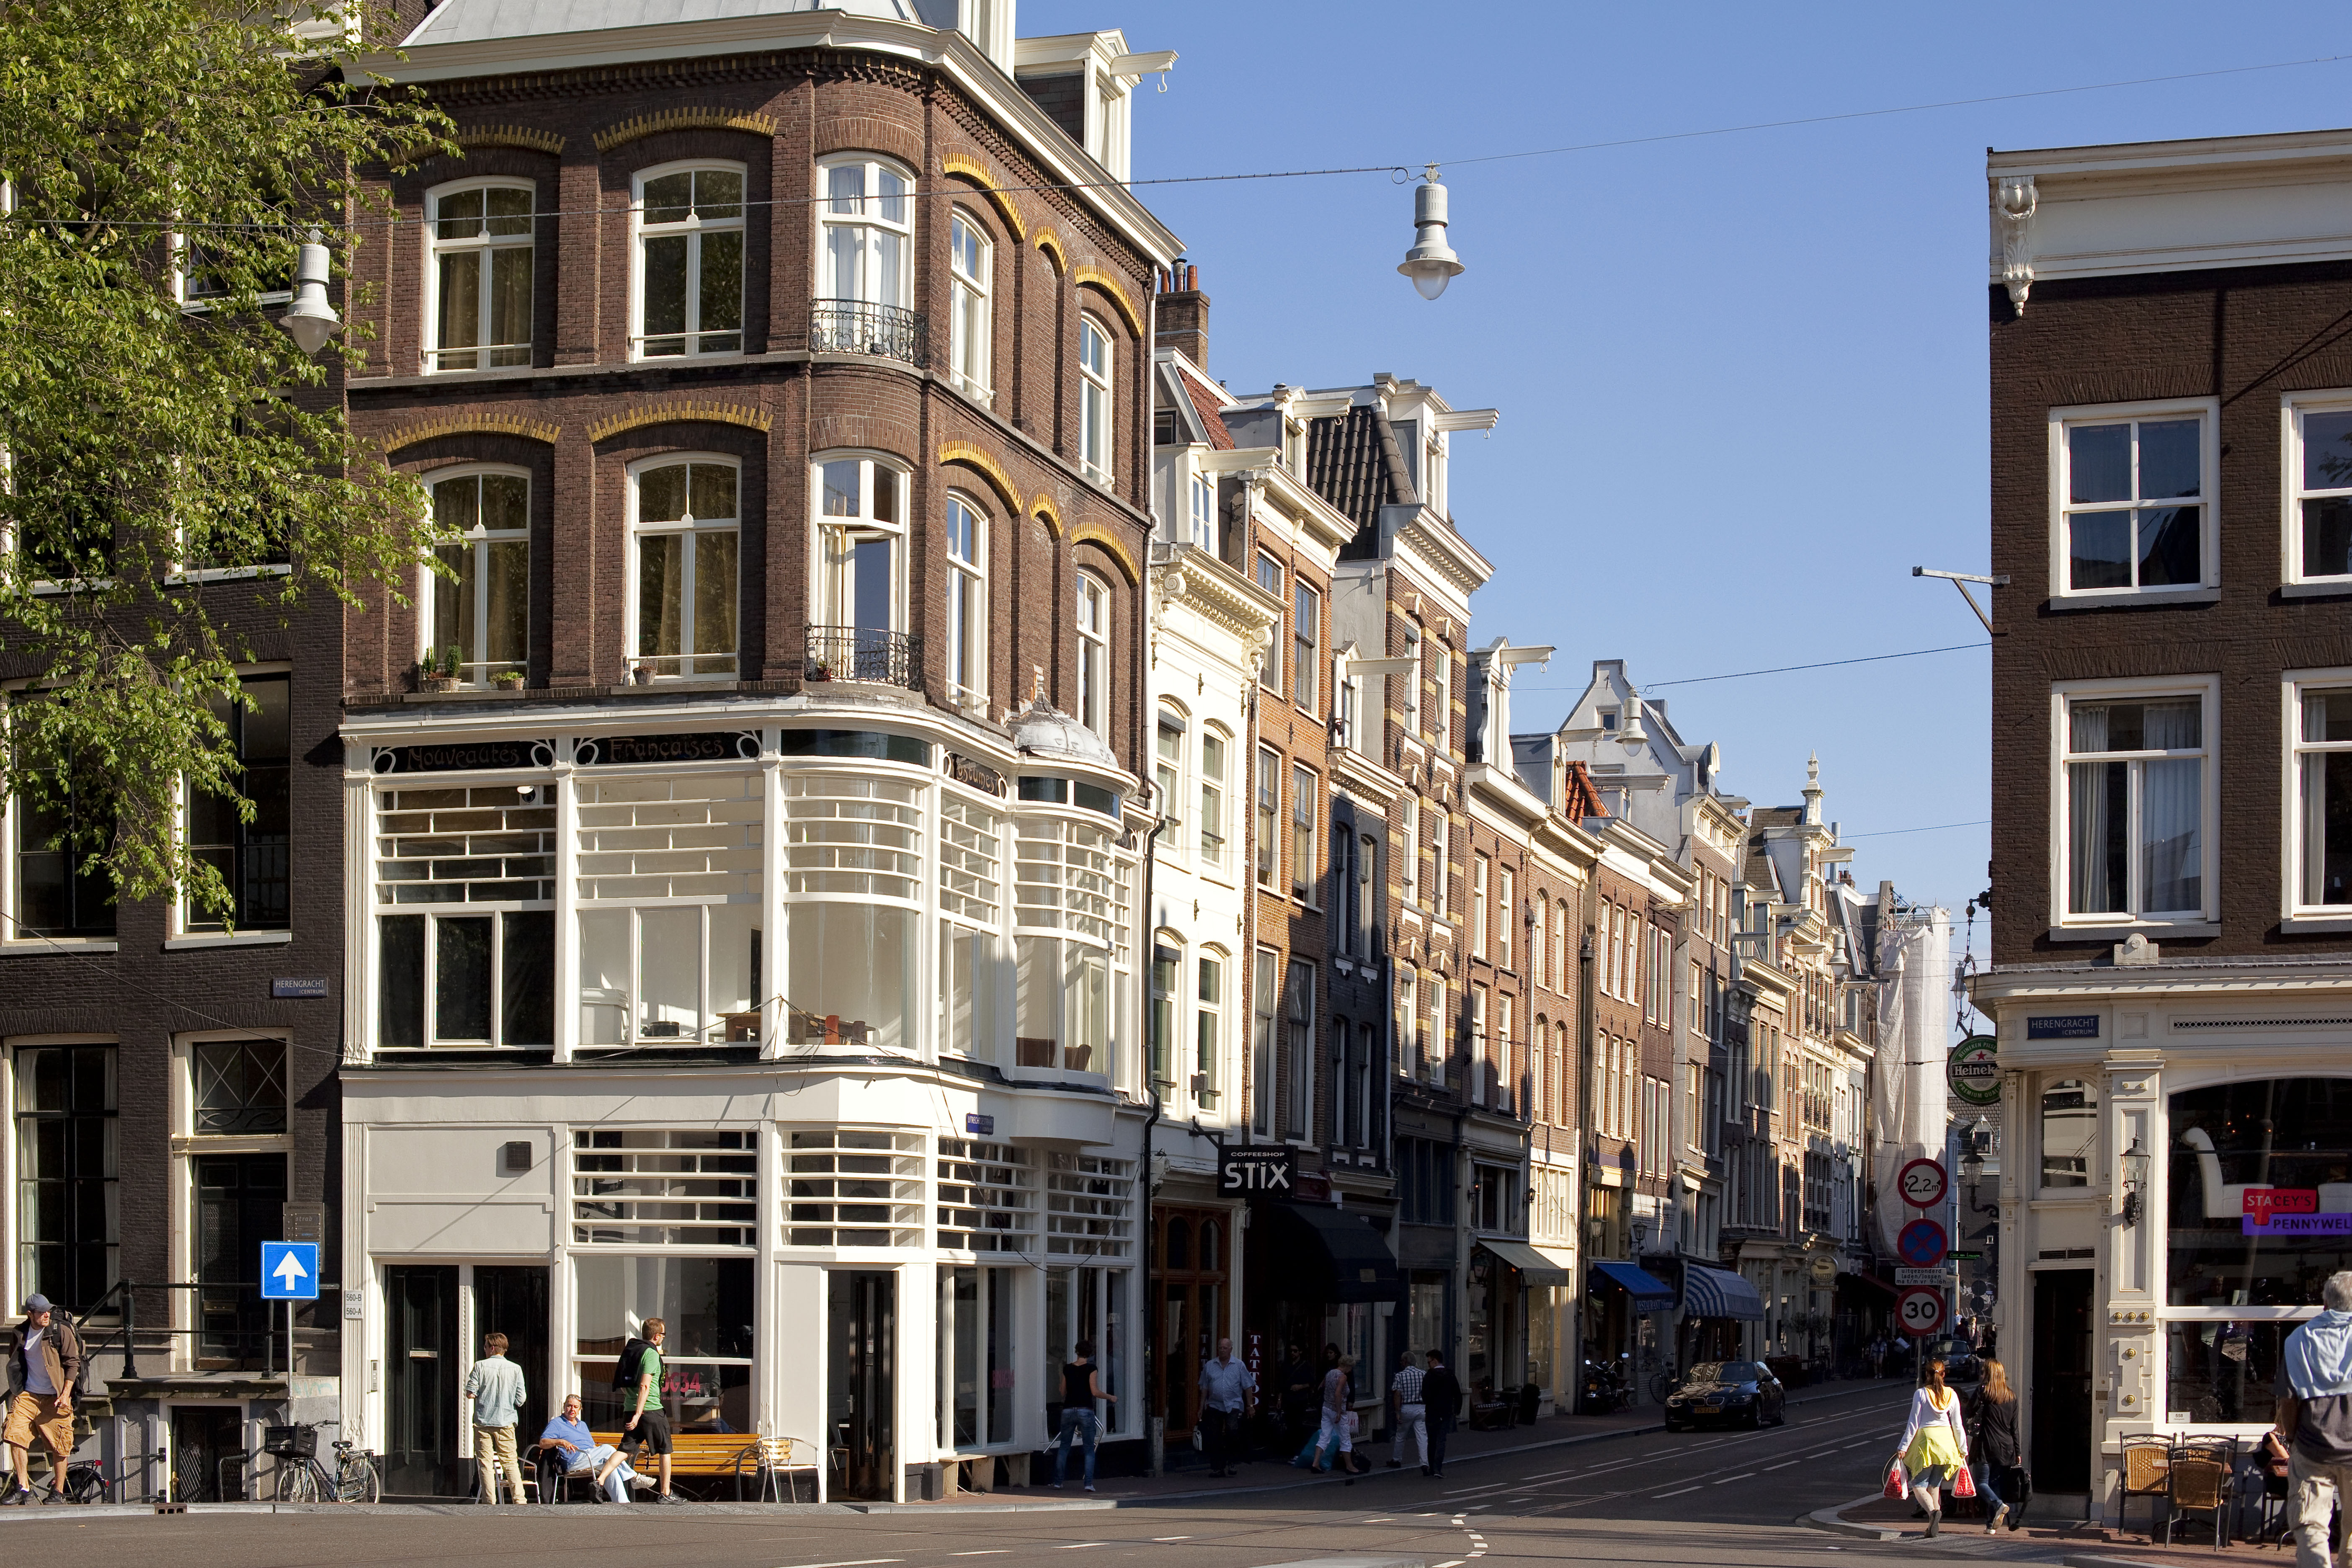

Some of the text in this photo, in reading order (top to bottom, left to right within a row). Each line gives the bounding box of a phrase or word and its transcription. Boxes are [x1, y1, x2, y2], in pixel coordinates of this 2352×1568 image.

[406, 744, 520, 771] Nouveautés
[609, 738, 724, 762] Françaises
[2032, 1019, 2095, 1029] HERENGRACHT
[1958, 1042, 1981, 1058] HEINEKEN
[1958, 1083, 2001, 1098] PREMIUM QUALIT
[1908, 1175, 1939, 1193] 2,2m
[2247, 1195, 2311, 1207] STACEY'S
[1905, 1302, 1936, 1319] 30
